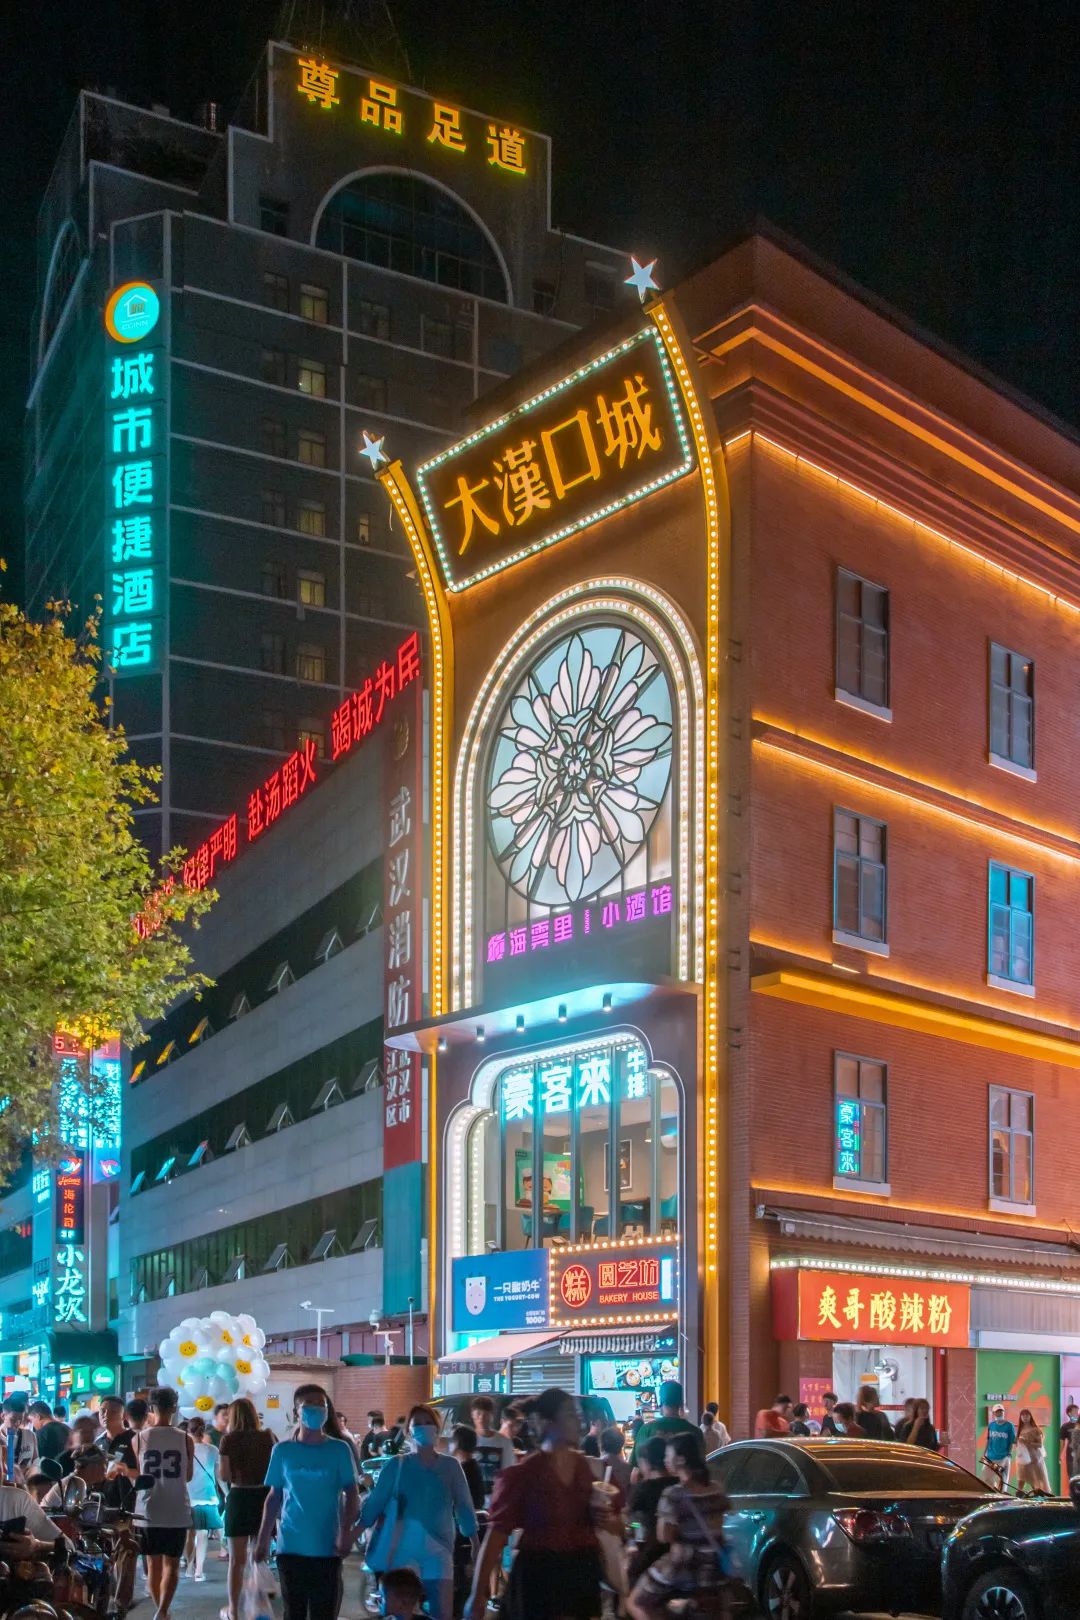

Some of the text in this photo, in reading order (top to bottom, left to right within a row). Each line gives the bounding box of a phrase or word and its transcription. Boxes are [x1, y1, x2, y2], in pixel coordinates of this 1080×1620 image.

[298, 58, 526, 175] 尊品足道
[444, 375, 661, 556] 大漢口城
[110, 352, 154, 669] 城市便捷酒店
[248, 738, 317, 841] 赴汤蹈火
[332, 632, 420, 761] 竭诚为民
[388, 786, 411, 1030] 武汉消防
[602, 885, 672, 928] 小酒馆
[63, 1189, 75, 1228] 海伦司
[55, 1244, 87, 1322] 小龙坎
[493, 1280, 540, 1294] 一只酸奶牛
[600, 1291, 659, 1303] BAKERY HOUSE
[818, 1285, 952, 1334] 爽哥酸辣粉
[144, 1449, 181, 1479] 23
